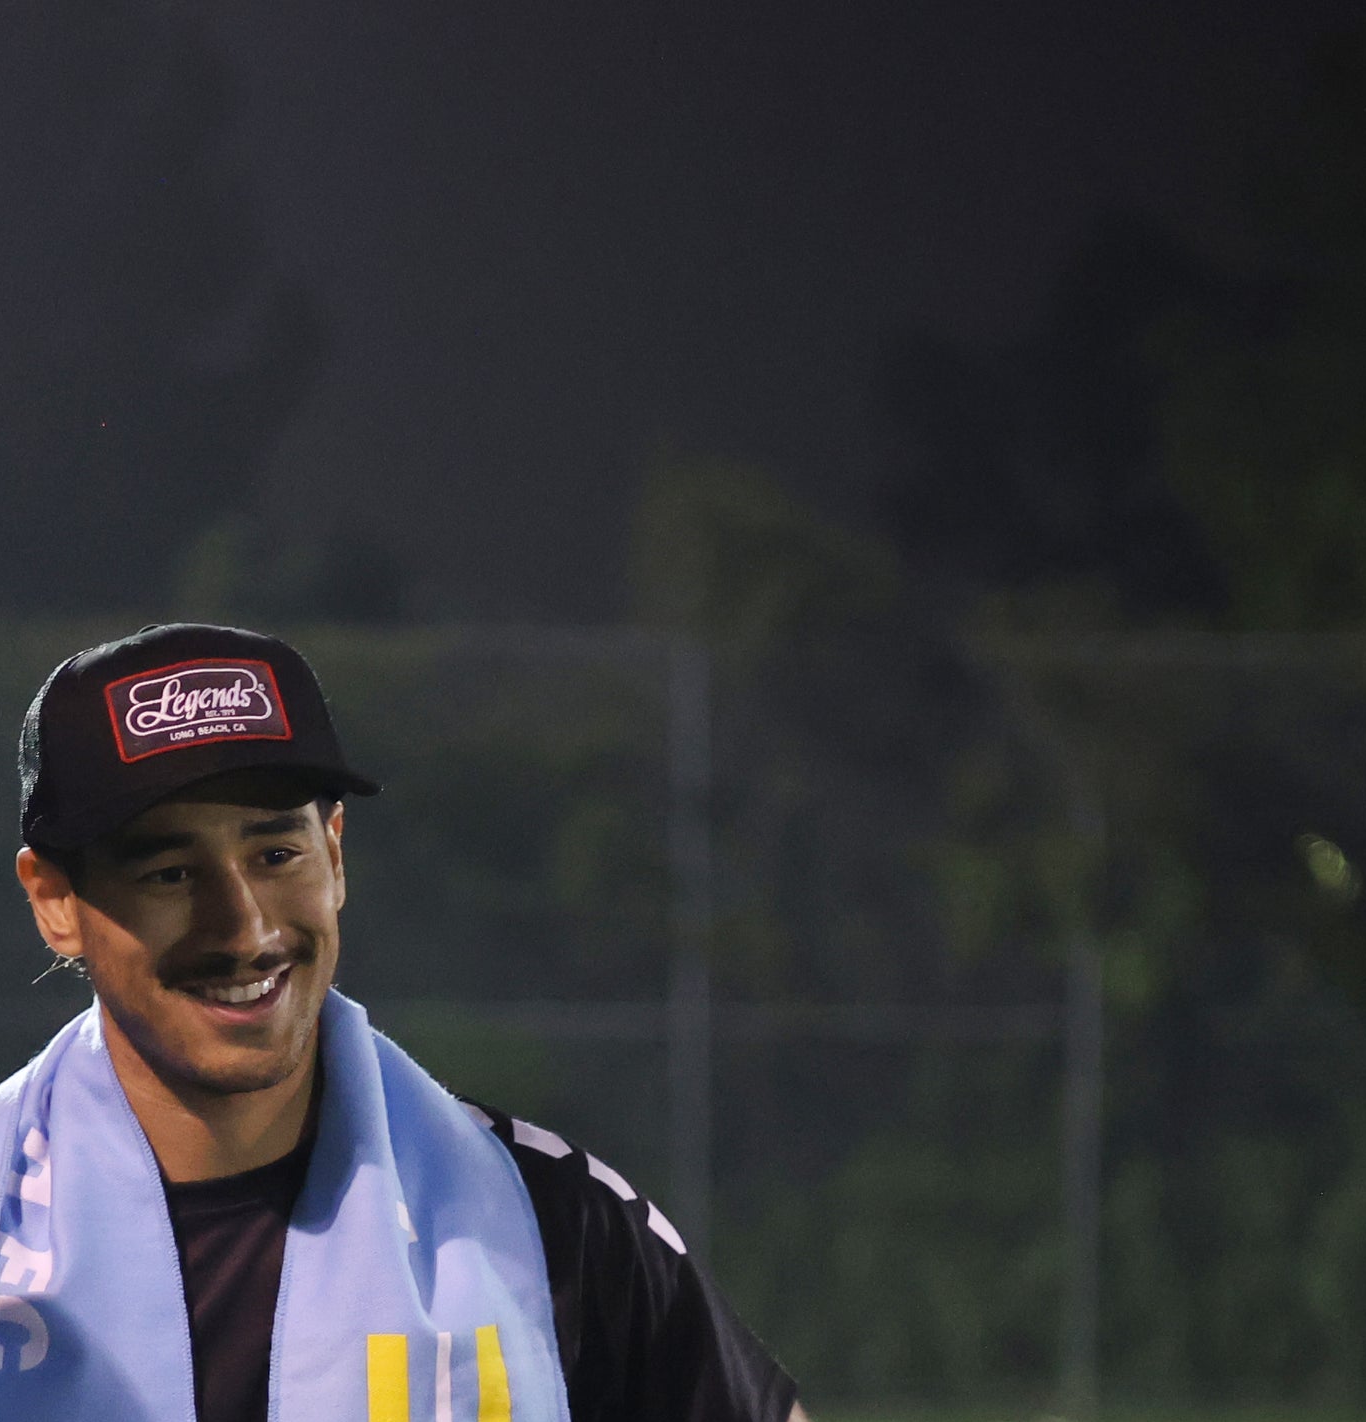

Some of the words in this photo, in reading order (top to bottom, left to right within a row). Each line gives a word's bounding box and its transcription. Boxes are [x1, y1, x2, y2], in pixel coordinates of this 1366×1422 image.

[136, 678, 253, 728] Legends
[170, 729, 195, 741] LONG
[197, 724, 231, 736] BEACH,
[232, 722, 247, 732] CA
